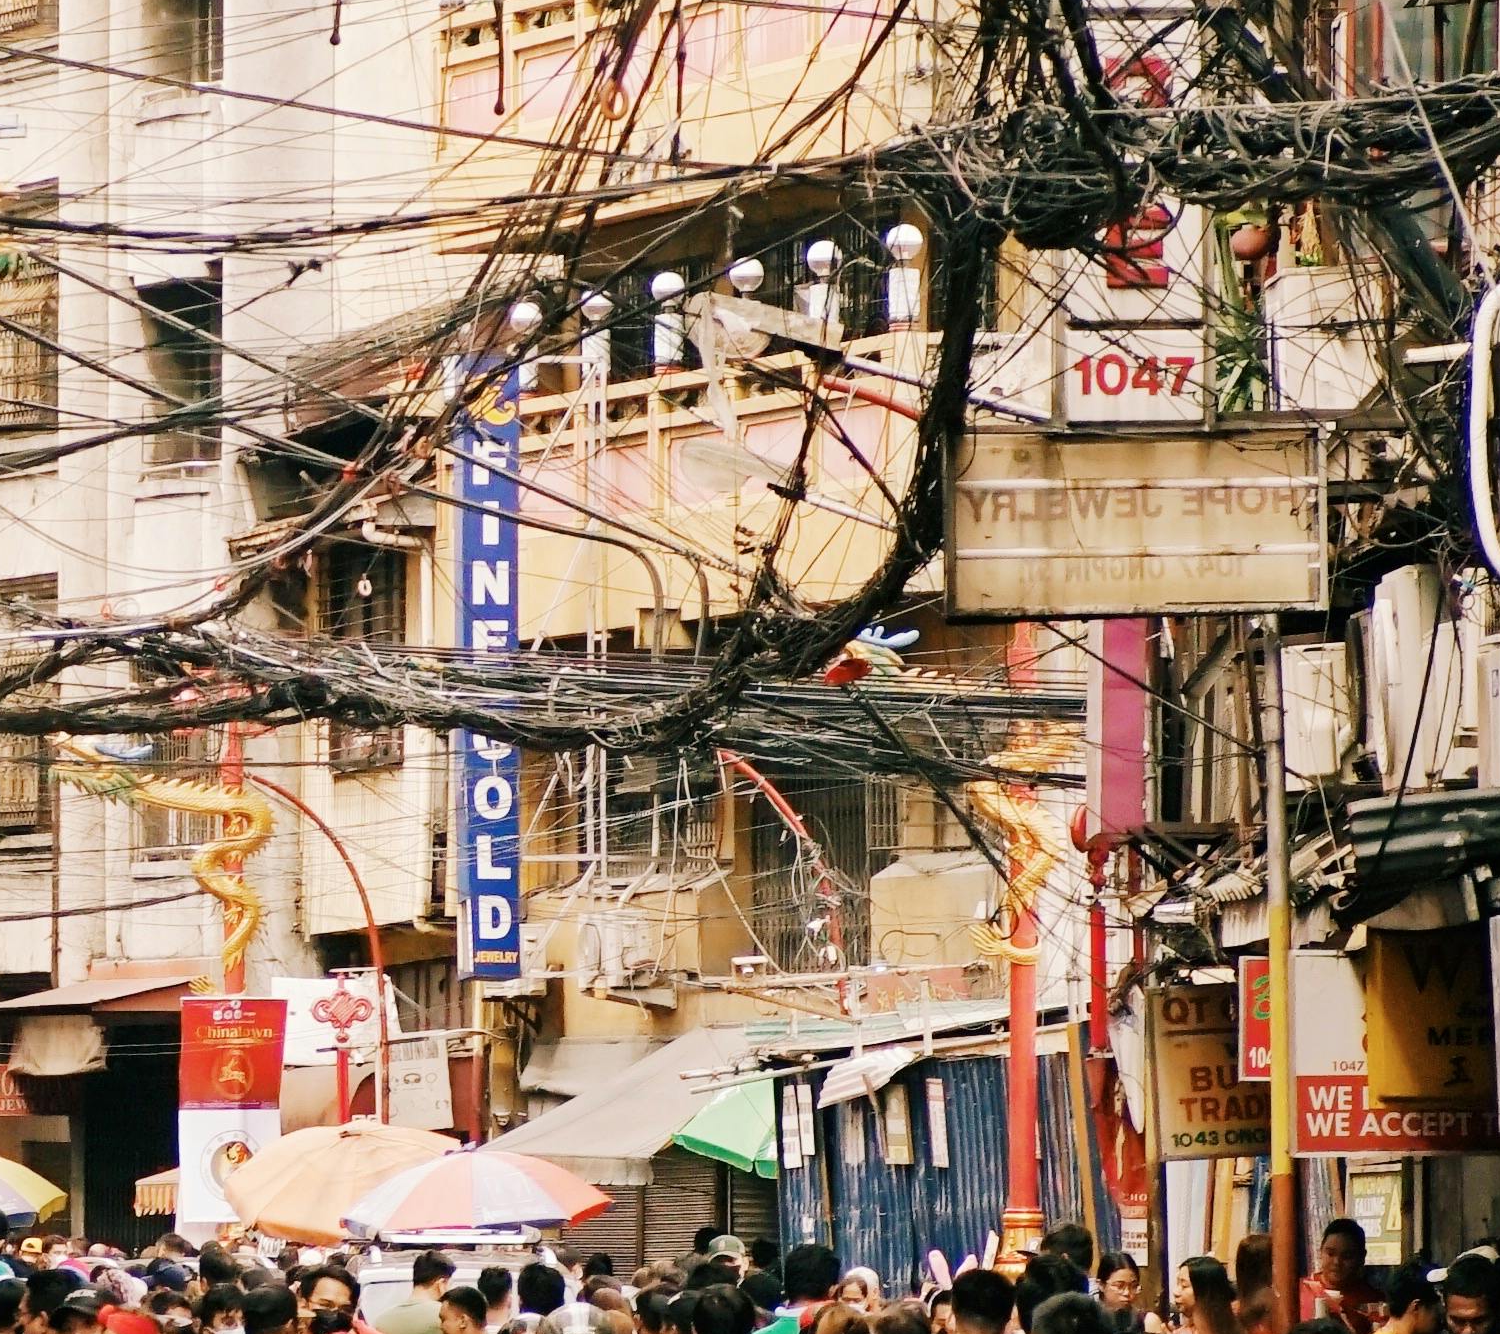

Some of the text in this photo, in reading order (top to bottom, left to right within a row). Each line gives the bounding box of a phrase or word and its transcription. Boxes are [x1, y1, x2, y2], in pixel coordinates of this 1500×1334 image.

[1072, 354, 1195, 395] 1047
[473, 943, 520, 964] JEWELRY
[196, 1026, 273, 1039] Chinatown
[1189, 1066, 1240, 1091] BU
[1332, 1060, 1364, 1073] 1047
[1179, 1096, 1266, 1123] TRAD
[1307, 1085, 1354, 1112] WE
[1306, 1112, 1351, 1138] WE
[1359, 1111, 1472, 1138] ACCEPT
[1171, 1127, 1267, 1148] 1043 ONG
